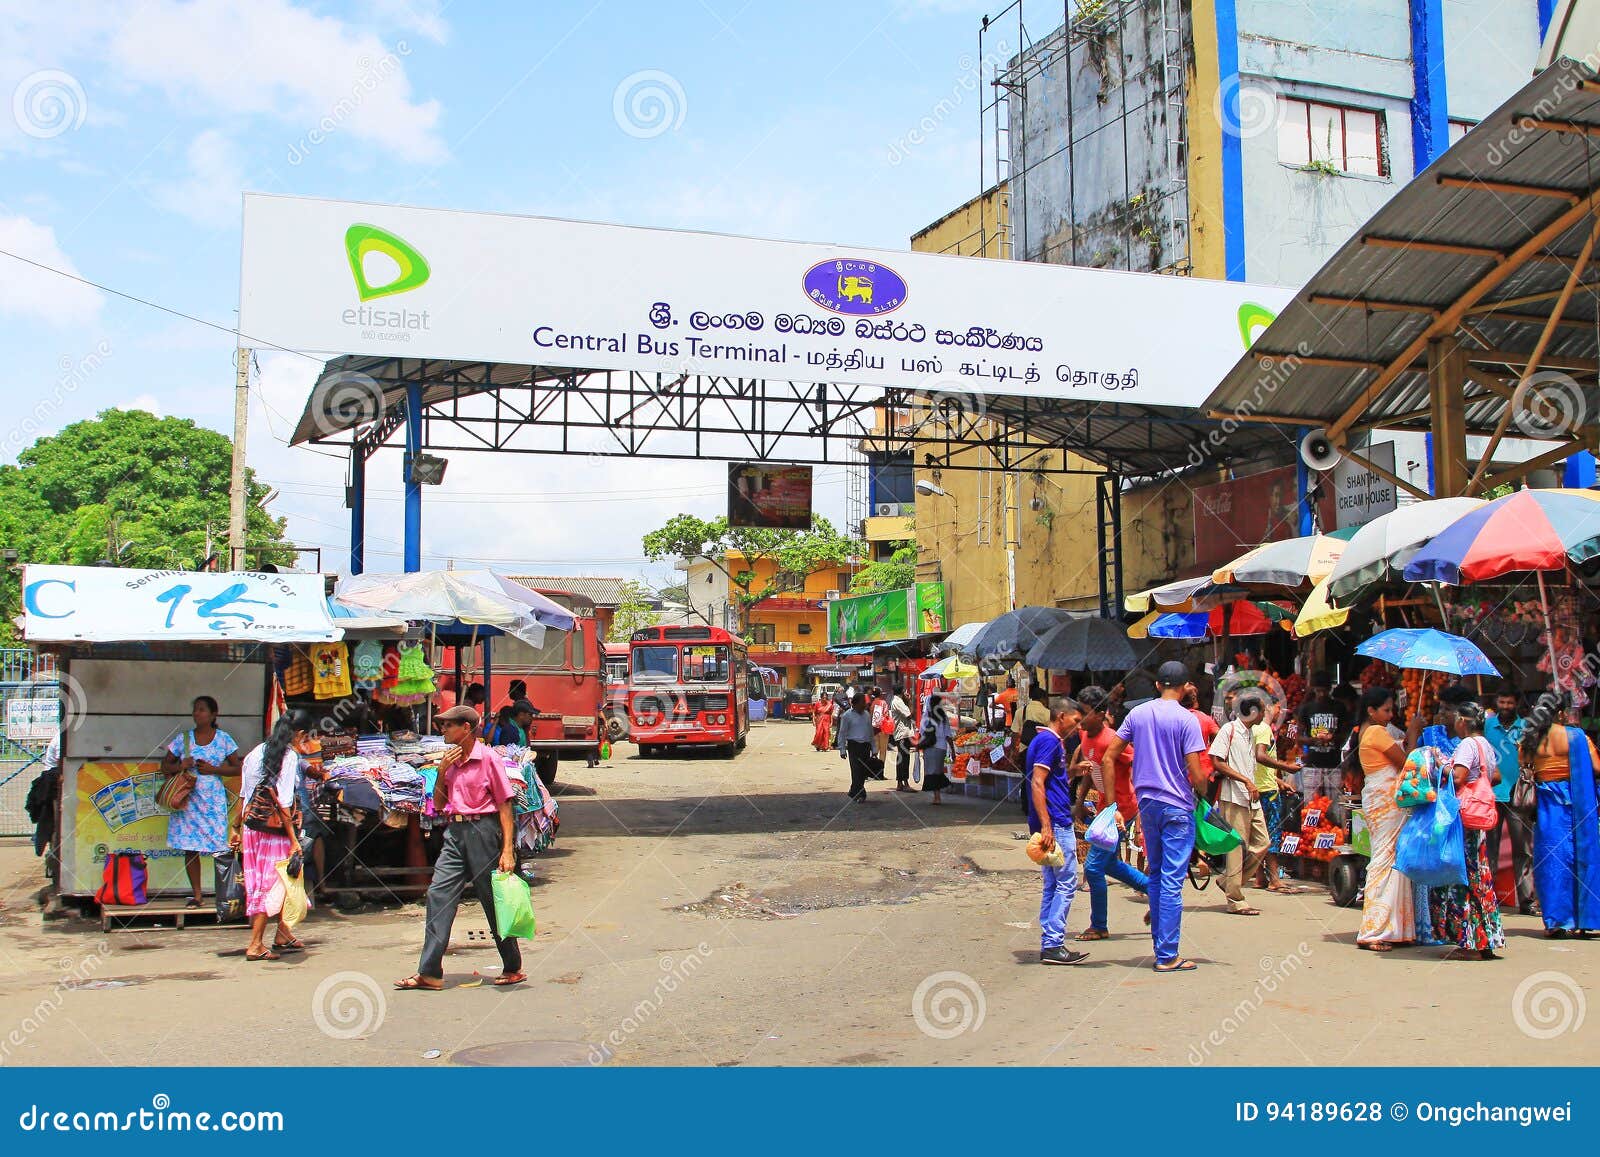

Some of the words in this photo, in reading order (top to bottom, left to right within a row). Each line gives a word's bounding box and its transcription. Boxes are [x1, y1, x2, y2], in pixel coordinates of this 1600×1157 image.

[342, 306, 430, 330] etisalat
[690, 311, 765, 331] ලංගම
[533, 326, 626, 353] Central
[637, 334, 679, 356] Bus
[685, 337, 786, 363] Terminal
[808, 348, 884, 371] மத்திய
[902, 355, 942, 373] பஸ்
[959, 359, 1041, 384] கட்டிடத்
[1056, 364, 1139, 390] தொகுதி
[1339, 492, 1363, 509] CREAM
[1365, 488, 1390, 505] HOUSE
[271, 578, 297, 597] For
[25, 579, 75, 619] C
[1307, 815, 1319, 826] 100
[1283, 844, 1296, 853] 100
[1317, 838, 1334, 848] 100
